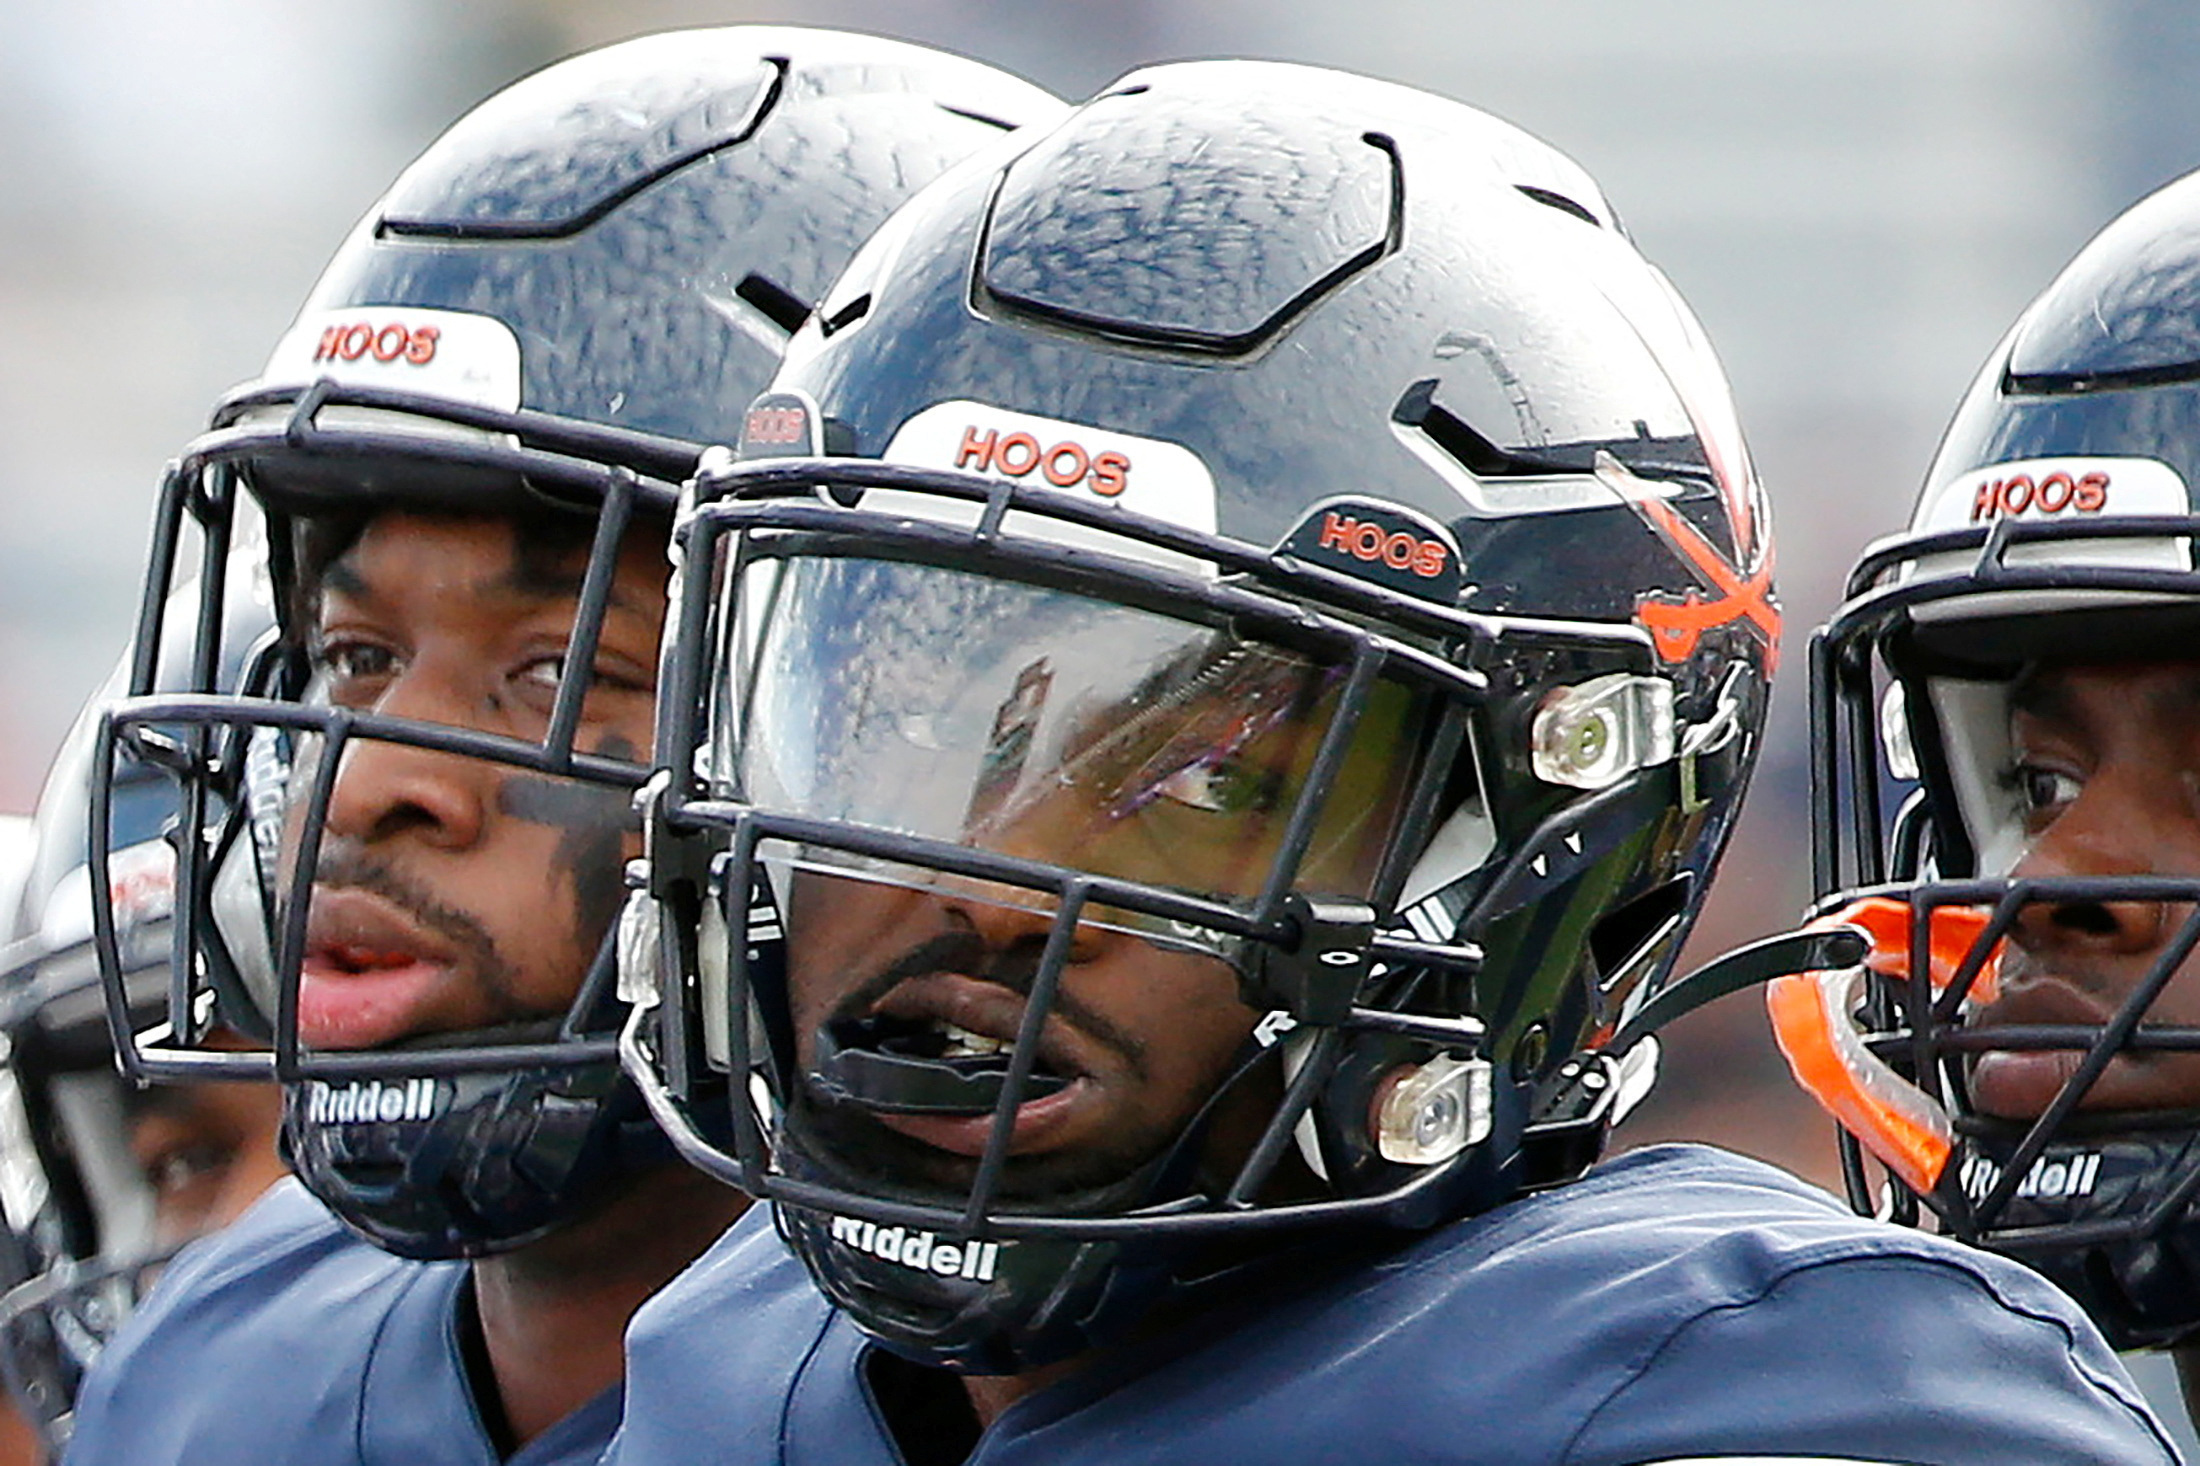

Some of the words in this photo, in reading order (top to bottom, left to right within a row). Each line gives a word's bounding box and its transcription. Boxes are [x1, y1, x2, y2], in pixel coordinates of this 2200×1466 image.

[314, 322, 440, 366] HOOS
[954, 424, 1131, 497] HOOS
[1969, 470, 2110, 521] HOOS
[1319, 511, 1449, 578] HOOS
[308, 1078, 435, 1122] Riddell
[832, 1215, 999, 1281] Riddell
